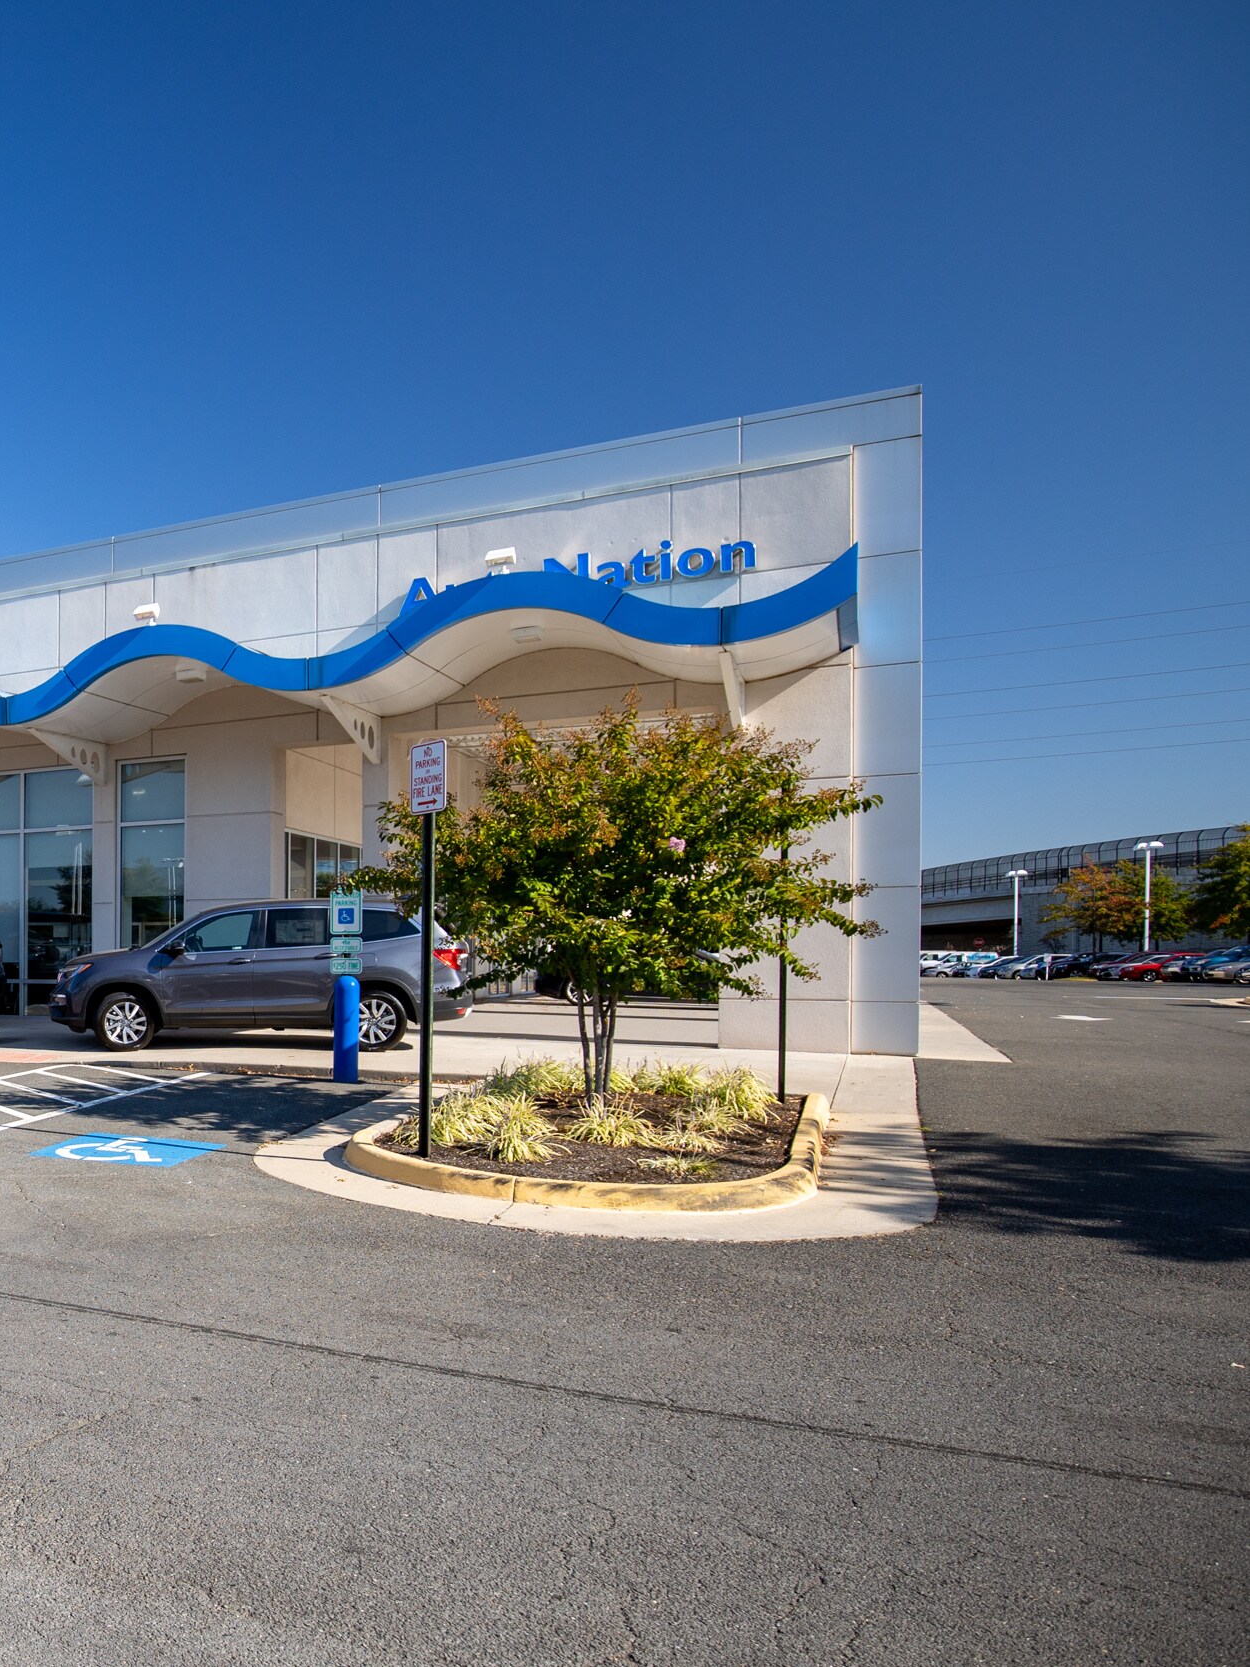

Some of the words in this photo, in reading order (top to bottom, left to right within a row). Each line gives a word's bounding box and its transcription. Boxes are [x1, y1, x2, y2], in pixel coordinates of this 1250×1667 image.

[543, 540, 756, 589] Nation
[423, 747, 433, 758] NO
[415, 757, 441, 769] PARKING
[414, 774, 442, 786] STANDING
[413, 786, 425, 798] FIRE
[427, 784, 442, 796] LANE
